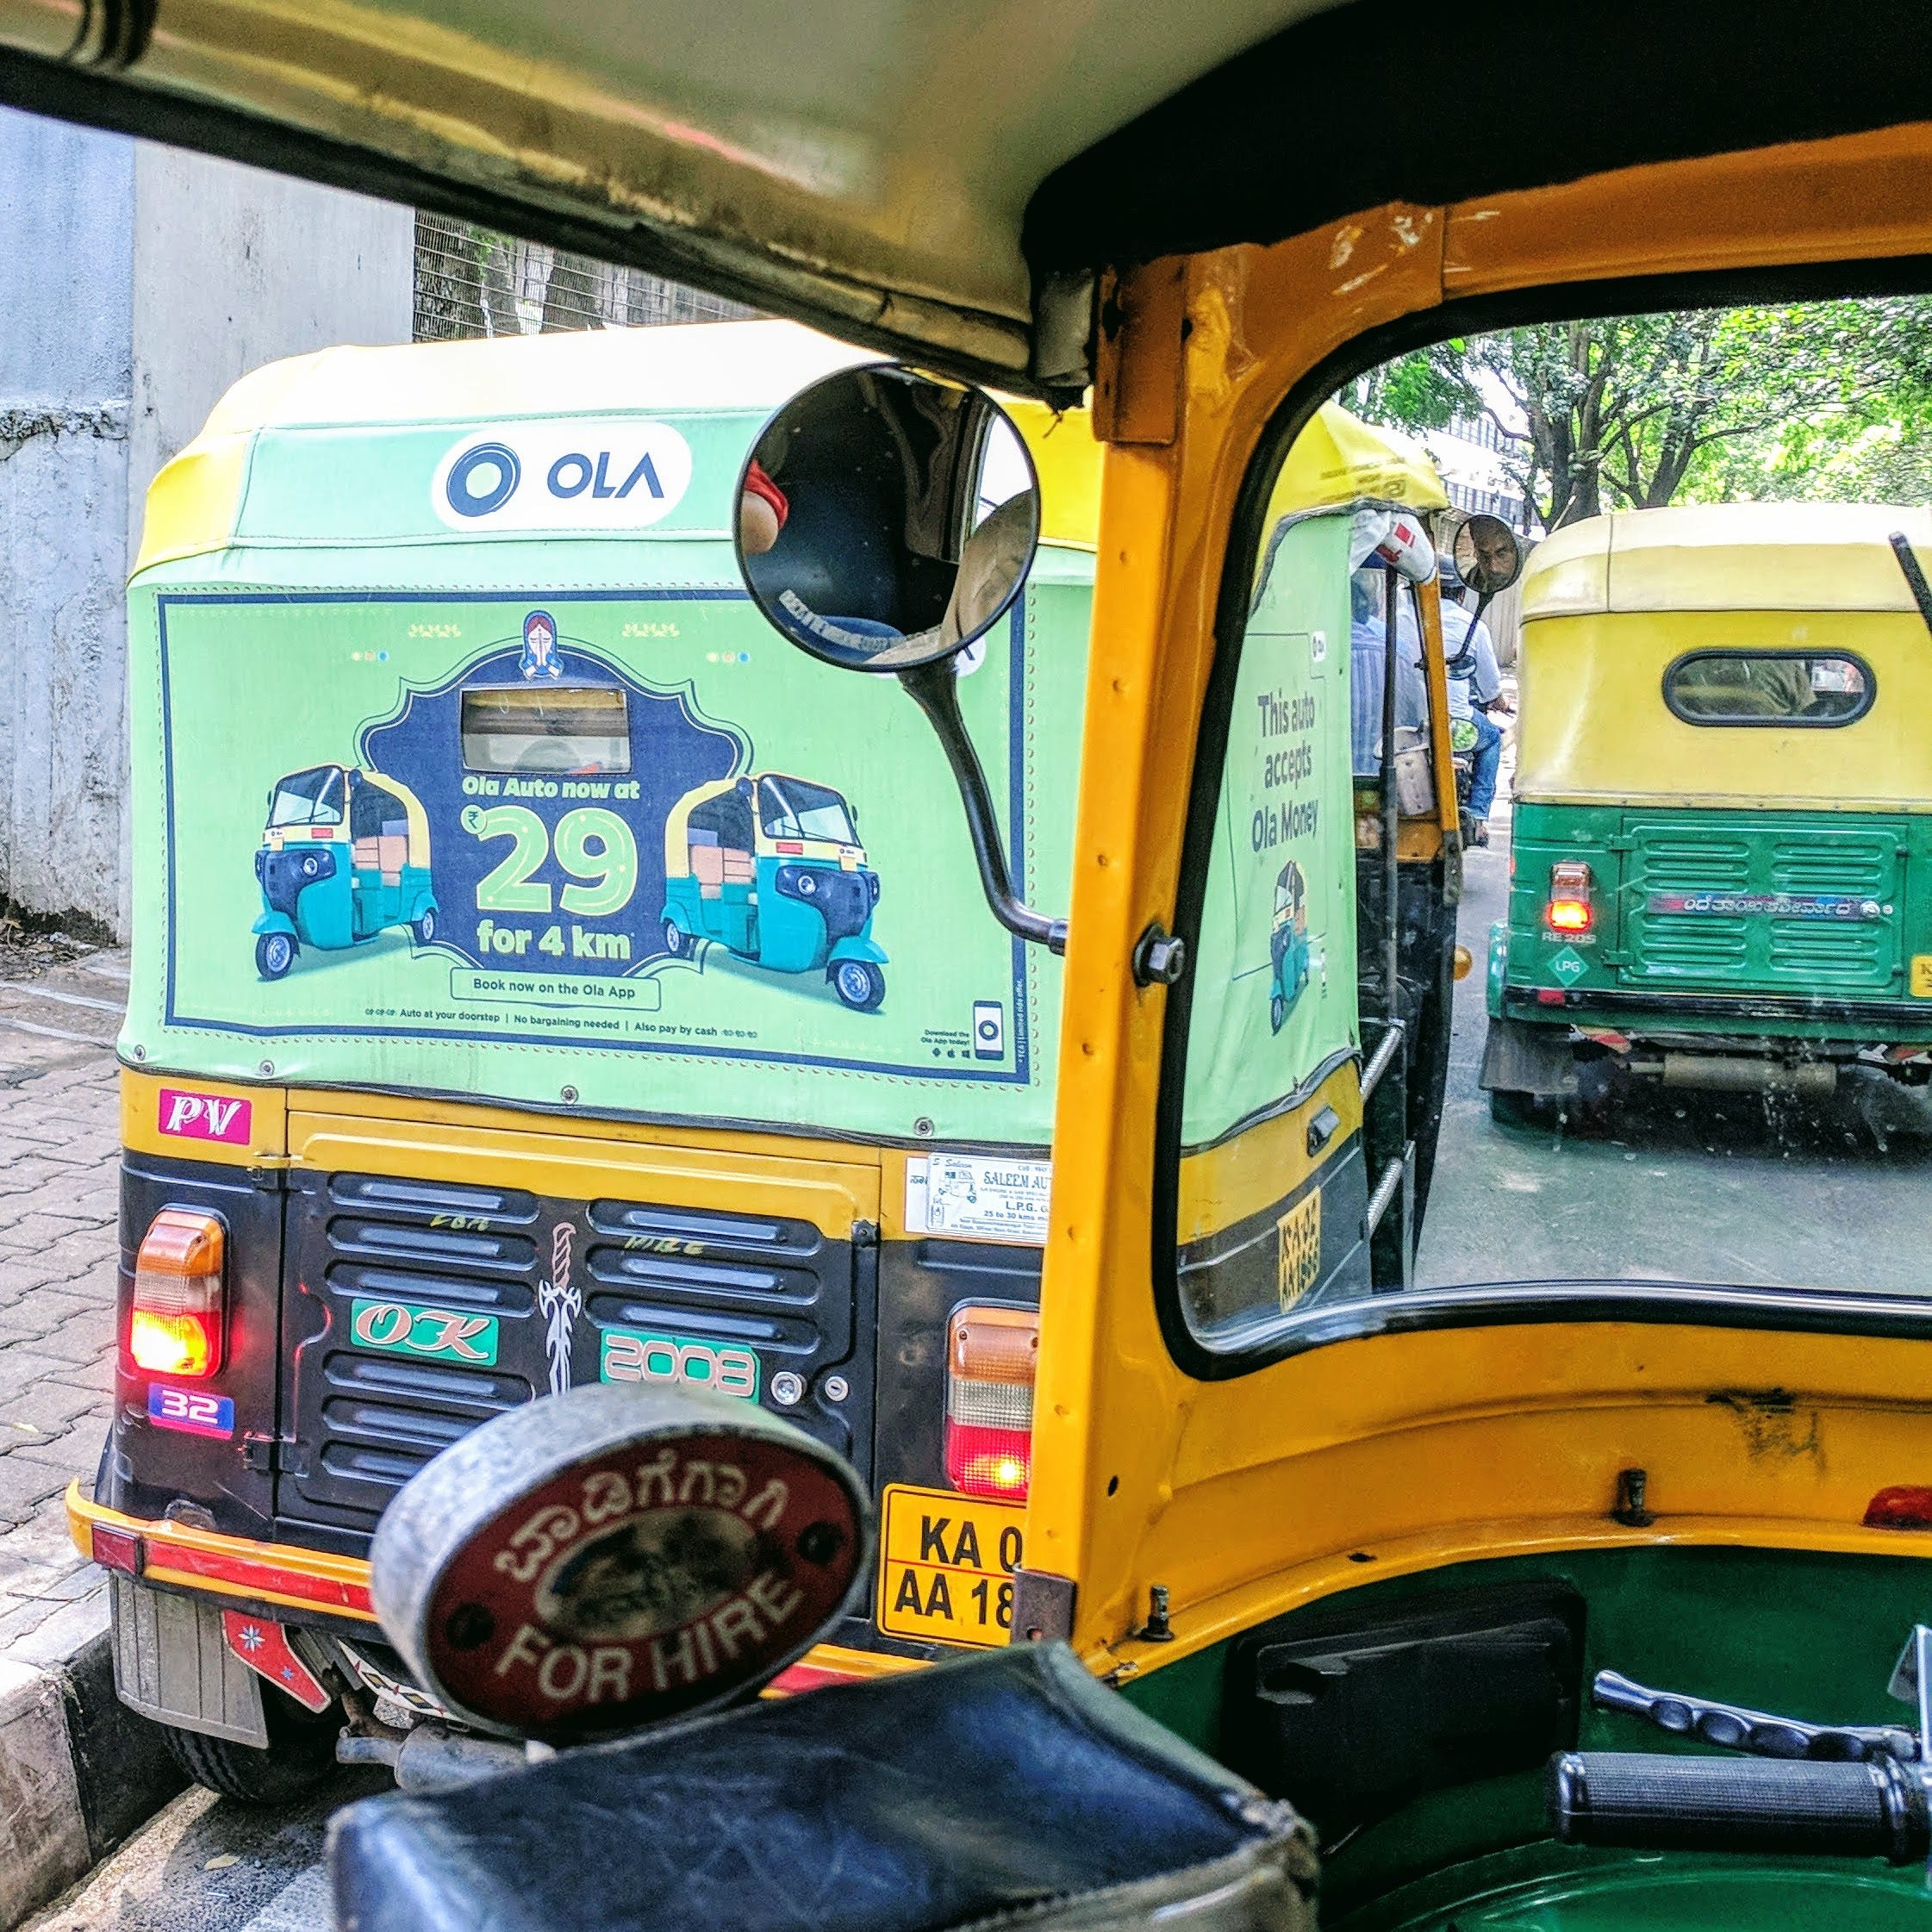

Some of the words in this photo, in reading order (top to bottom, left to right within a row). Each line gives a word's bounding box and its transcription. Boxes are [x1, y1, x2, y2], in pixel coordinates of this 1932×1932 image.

[547, 452, 664, 498] OLA
[1257, 688, 1288, 737] This
[1292, 691, 1315, 732] auto
[462, 776, 499, 795] Ola
[503, 777, 558, 798] Auto
[562, 781, 610, 799] now
[614, 781, 640, 799] at
[1264, 739, 1312, 789] accepts
[1252, 806, 1277, 852] Ola
[1281, 800, 1318, 842] Money
[477, 919, 533, 955] for
[539, 925, 565, 956] 4
[473, 978, 506, 990] Book
[509, 982, 534, 992] now
[539, 984, 554, 993] on
[558, 983, 578, 994] the
[583, 984, 604, 996] Ola
[608, 986, 635, 1000] App
[1555, 960, 1580, 973] LPG
[400, 1008, 421, 1018] Auto
[424, 1010, 433, 1019] at
[435, 1012, 456, 1020] your
[458, 1012, 500, 1023] doorstep
[514, 1014, 527, 1024] No
[530, 1016, 581, 1028] bargaining
[583, 1019, 620, 1029] needed
[634, 1022, 656, 1031] Also
[658, 1025, 676, 1034] pay
[680, 1025, 691, 1035] by
[695, 1027, 718, 1037] cash
[983, 1170, 1030, 1188] SALEEM
[356, 1304, 490, 1359] OK
[605, 1335, 756, 1397] 2008
[161, 1389, 219, 1424] 32
[920, 1515, 982, 1569] KA
[894, 1568, 954, 1621] AA
[495, 1624, 633, 1703] FOR
[651, 1568, 805, 1691] HIRE
